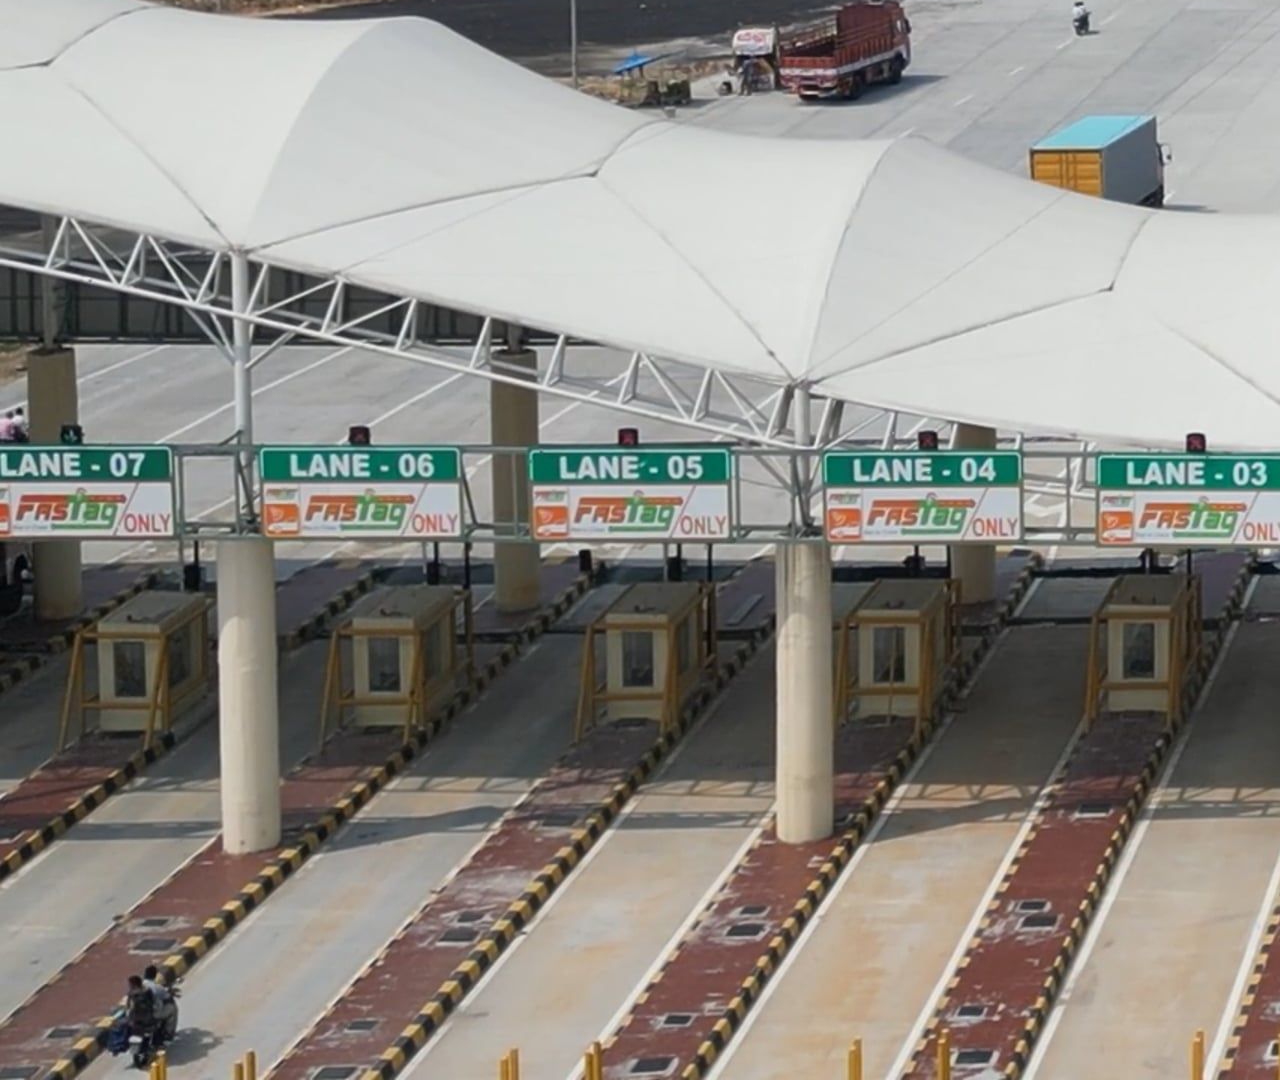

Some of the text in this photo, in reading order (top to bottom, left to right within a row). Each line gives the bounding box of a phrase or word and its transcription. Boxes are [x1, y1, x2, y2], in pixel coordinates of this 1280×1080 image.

[0, 452, 82, 477] LANE
[109, 452, 145, 477] 07
[290, 453, 371, 478] LANE
[398, 453, 434, 478] 06
[559, 455, 640, 480] LANE
[667, 455, 703, 480] 05
[853, 458, 933, 483] LANE
[960, 457, 996, 482] 04
[1126, 461, 1205, 486] LANE
[1232, 461, 1267, 486] 03
[124, 514, 170, 533] ONLY
[412, 514, 458, 533] ONLY
[680, 515, 726, 535] ONLY
[973, 518, 1018, 537] ONLY
